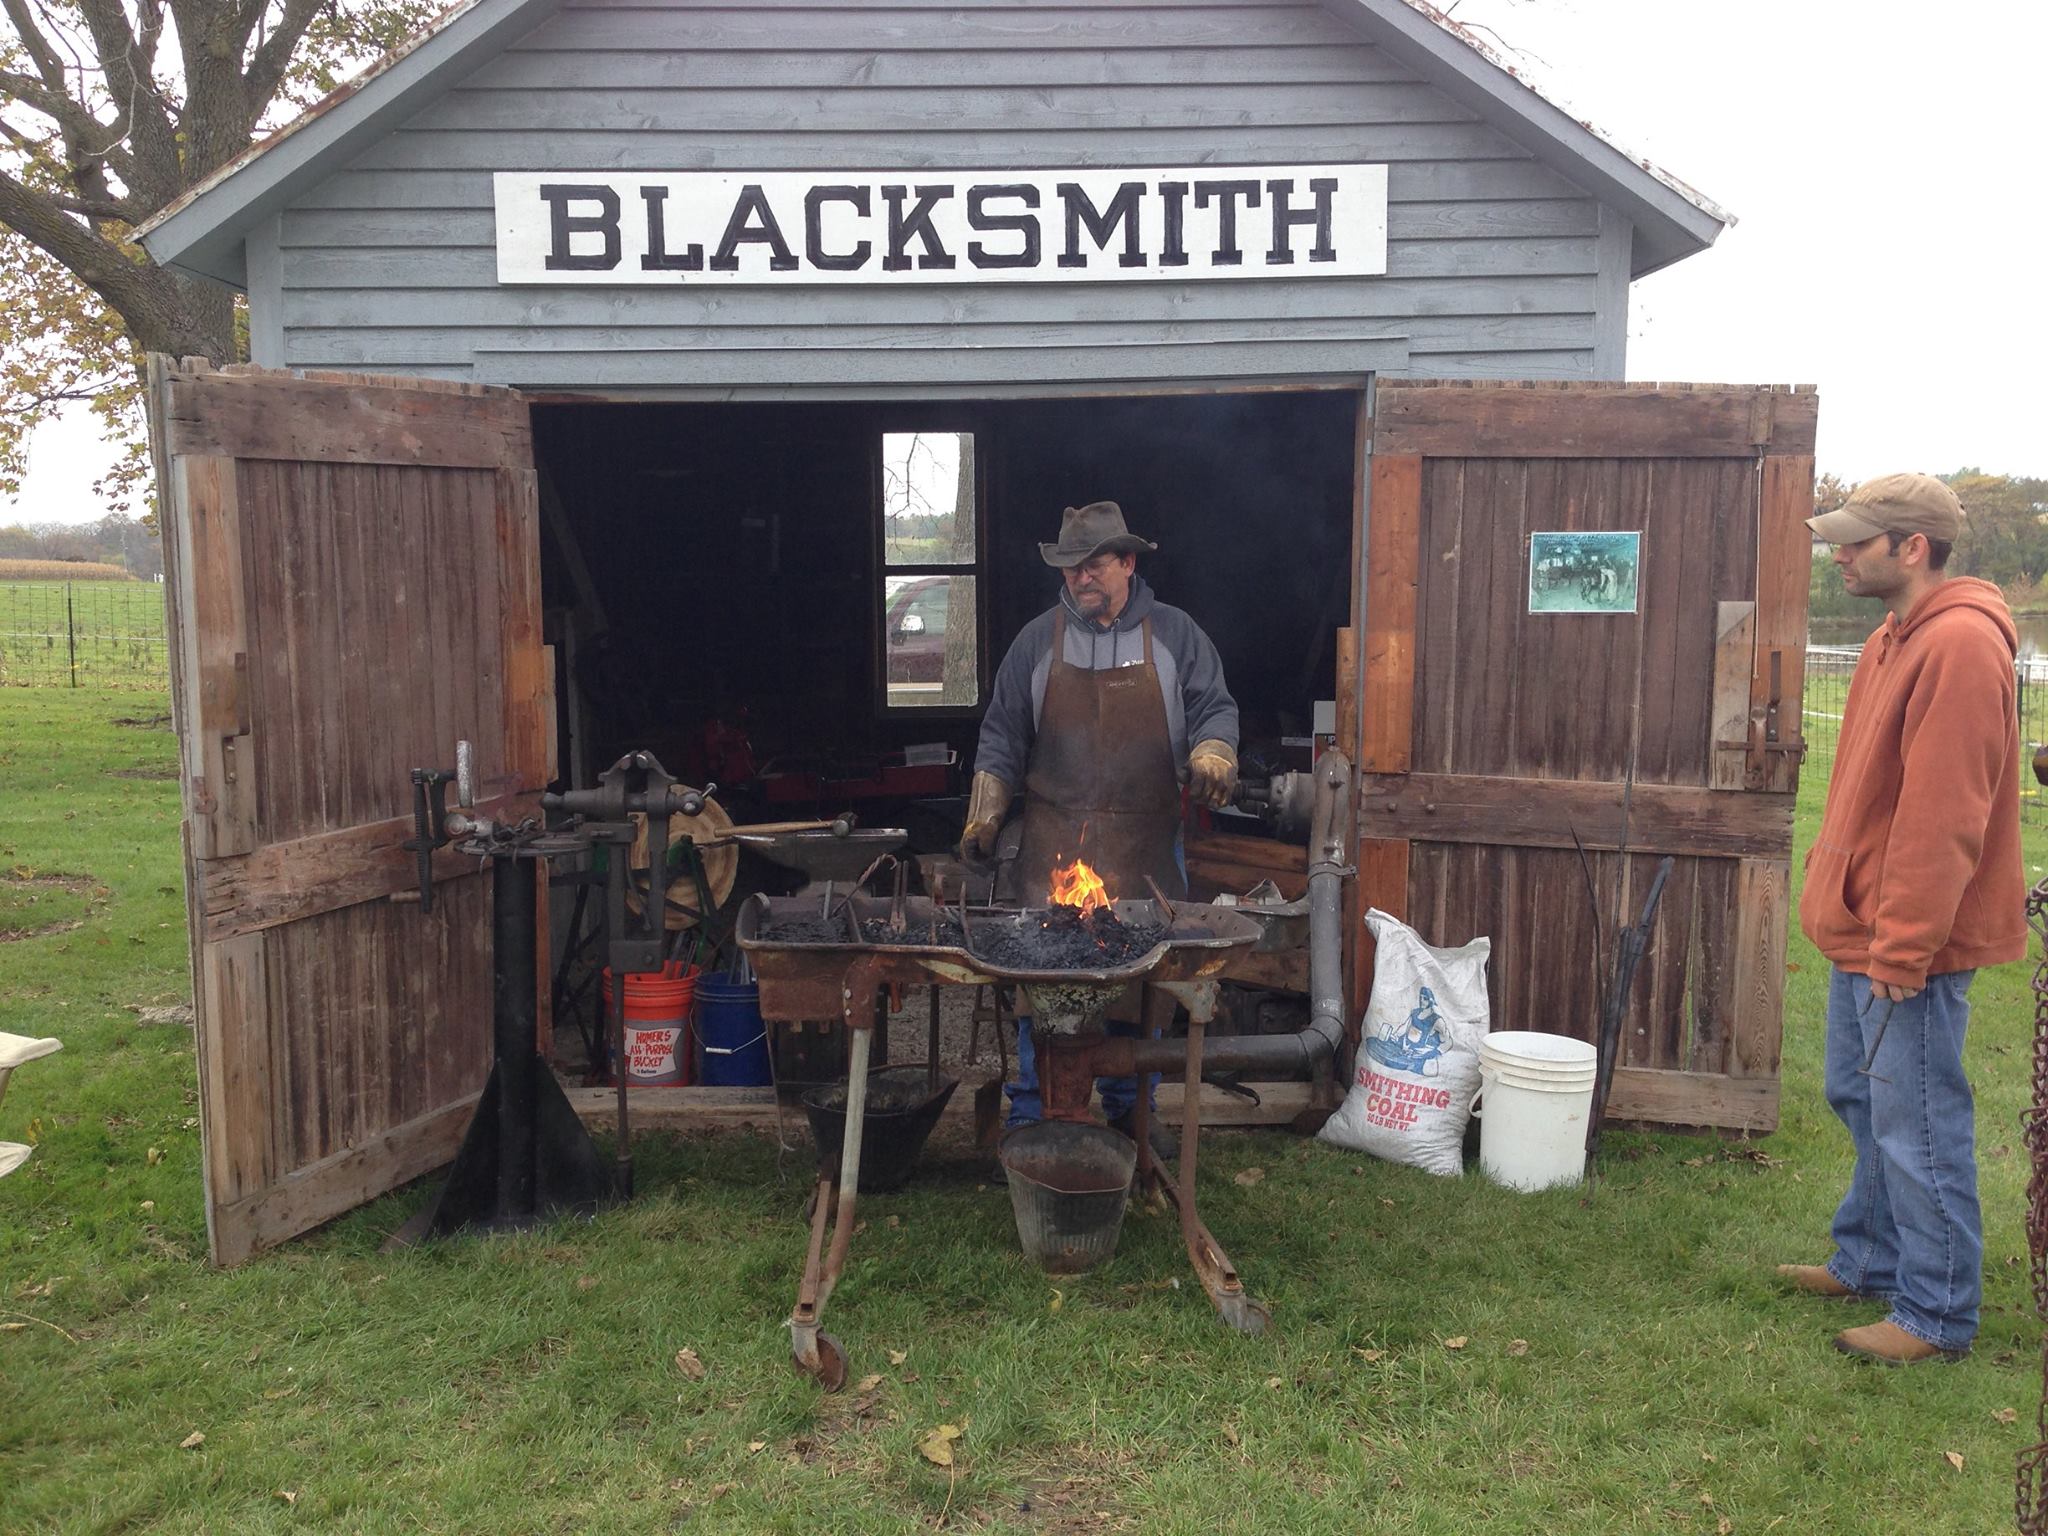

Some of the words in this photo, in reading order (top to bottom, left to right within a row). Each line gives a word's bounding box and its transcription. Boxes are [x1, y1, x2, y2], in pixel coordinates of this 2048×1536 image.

[539, 178, 1338, 271] BLACKSMITH
[634, 1056, 664, 1067] BUCKET
[1358, 1066, 1451, 1110] SMITHING
[1367, 1093, 1418, 1122] COAL
[1367, 1113, 1375, 1123] 50
[1374, 1115, 1384, 1127] LB
[1384, 1118, 1399, 1130] NET
